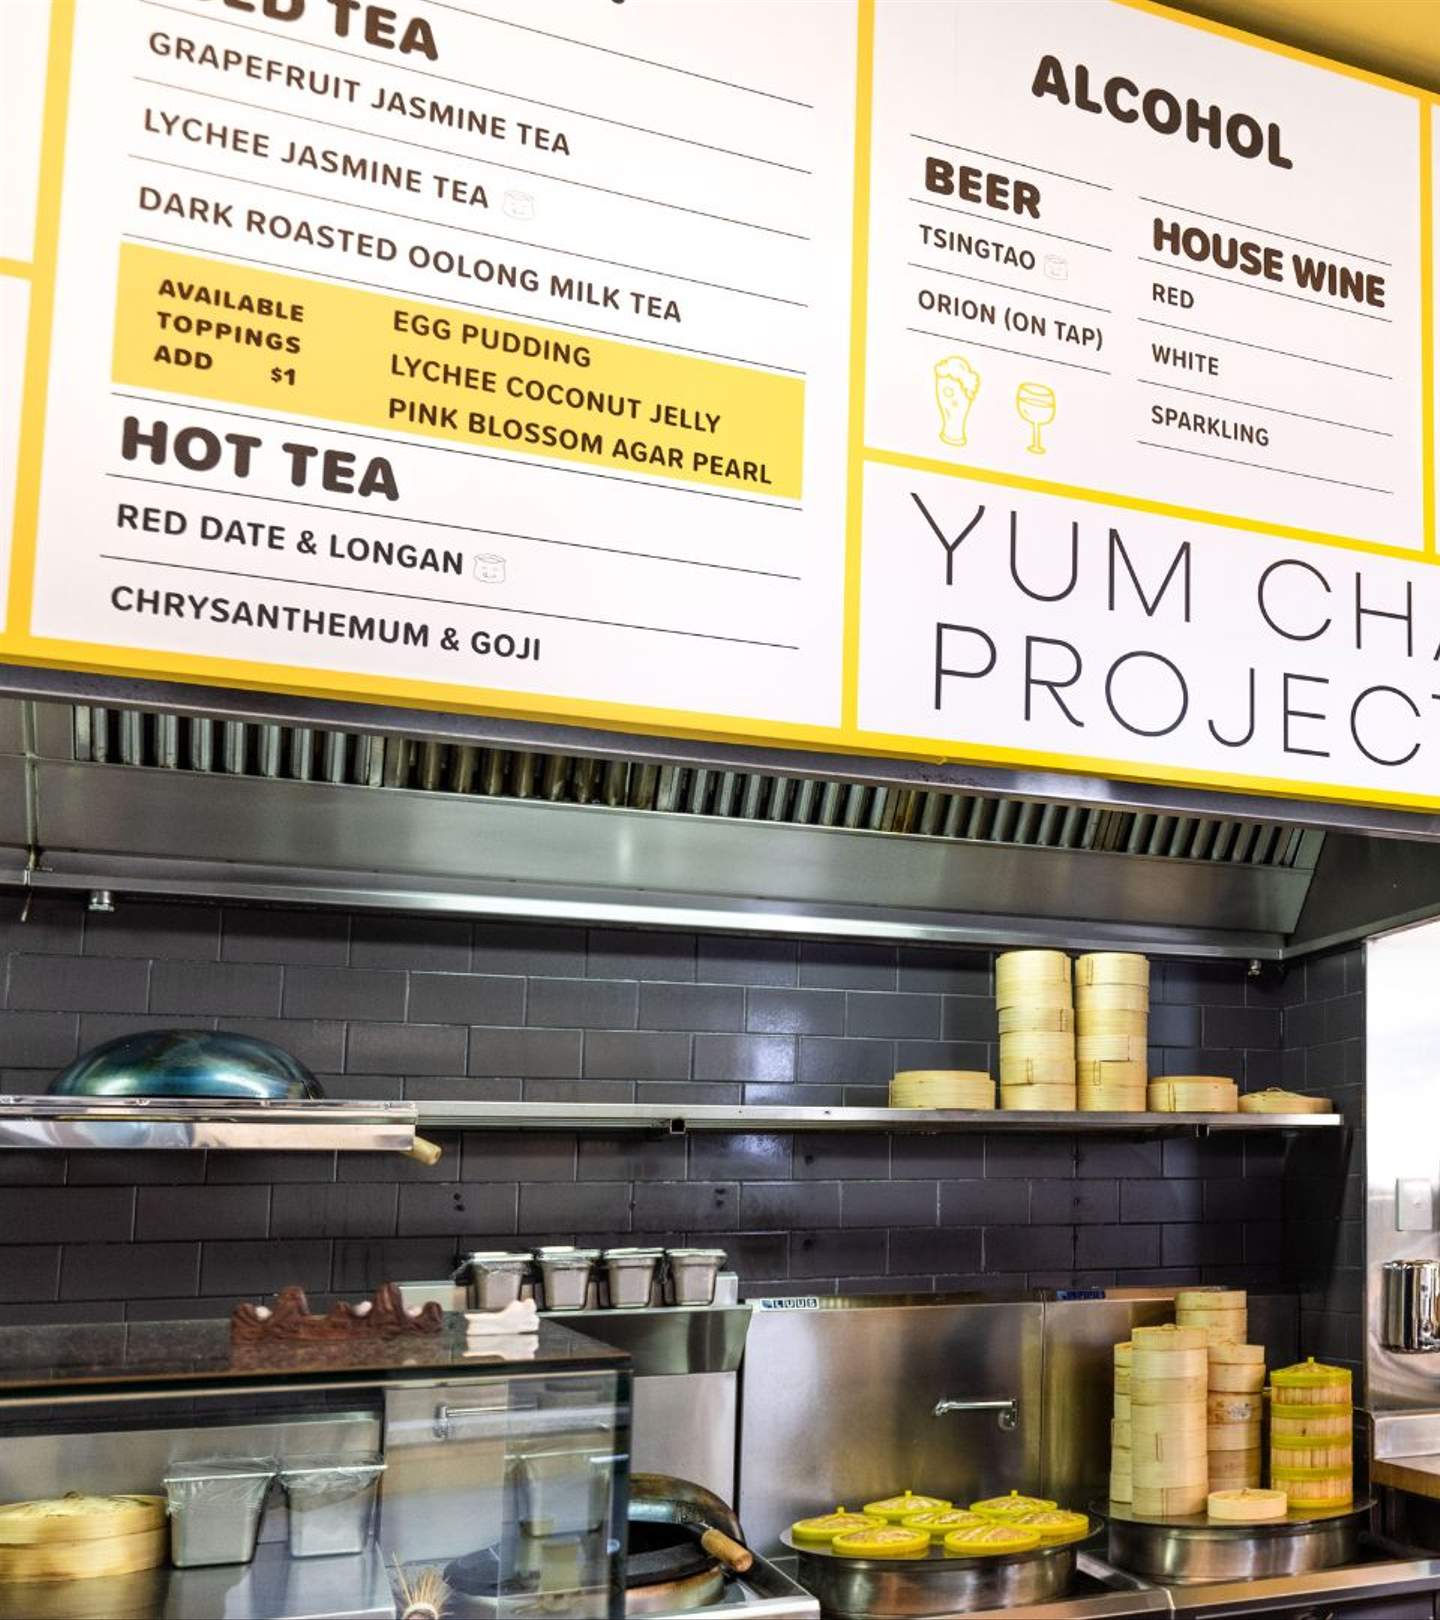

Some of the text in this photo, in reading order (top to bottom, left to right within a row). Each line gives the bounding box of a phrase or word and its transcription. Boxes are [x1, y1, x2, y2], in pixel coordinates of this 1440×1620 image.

[326, 0, 439, 61] TEA
[149, 32, 570, 156] GRAPEFRUIT JASMINE TEA
[1031, 54, 1294, 170] ALCOHOL
[145, 108, 489, 209] LYCHEE JASMINE TEA
[925, 156, 1041, 220] BEER
[139, 186, 681, 323] DARK ROASTED OOLONG MILK TEA
[919, 224, 1036, 270] TSINGTAO
[1153, 217, 1385, 308] HOUSE WINE
[157, 279, 305, 324] AVAILABLE
[918, 289, 1103, 352] ORION (ON TAP)
[1152, 282, 1195, 309] RED
[153, 345, 296, 386] ADD $1
[155, 311, 302, 356] TOPPINGS
[393, 310, 591, 368] EGG PUDDING
[1151, 343, 1219, 376] WHITE
[391, 353, 721, 434] LYCHEE COCONUT JELLY
[1151, 405, 1269, 447] SPARKLING
[121, 416, 400, 502] HOT TEA
[388, 397, 772, 485] PINK BLOSSOM AGAR PEARL
[117, 503, 463, 576] RED DATE & LONGAN
[910, 492, 1191, 623] YUM
[111, 585, 540, 661] CHRYSANTHEMUM & GOJI
